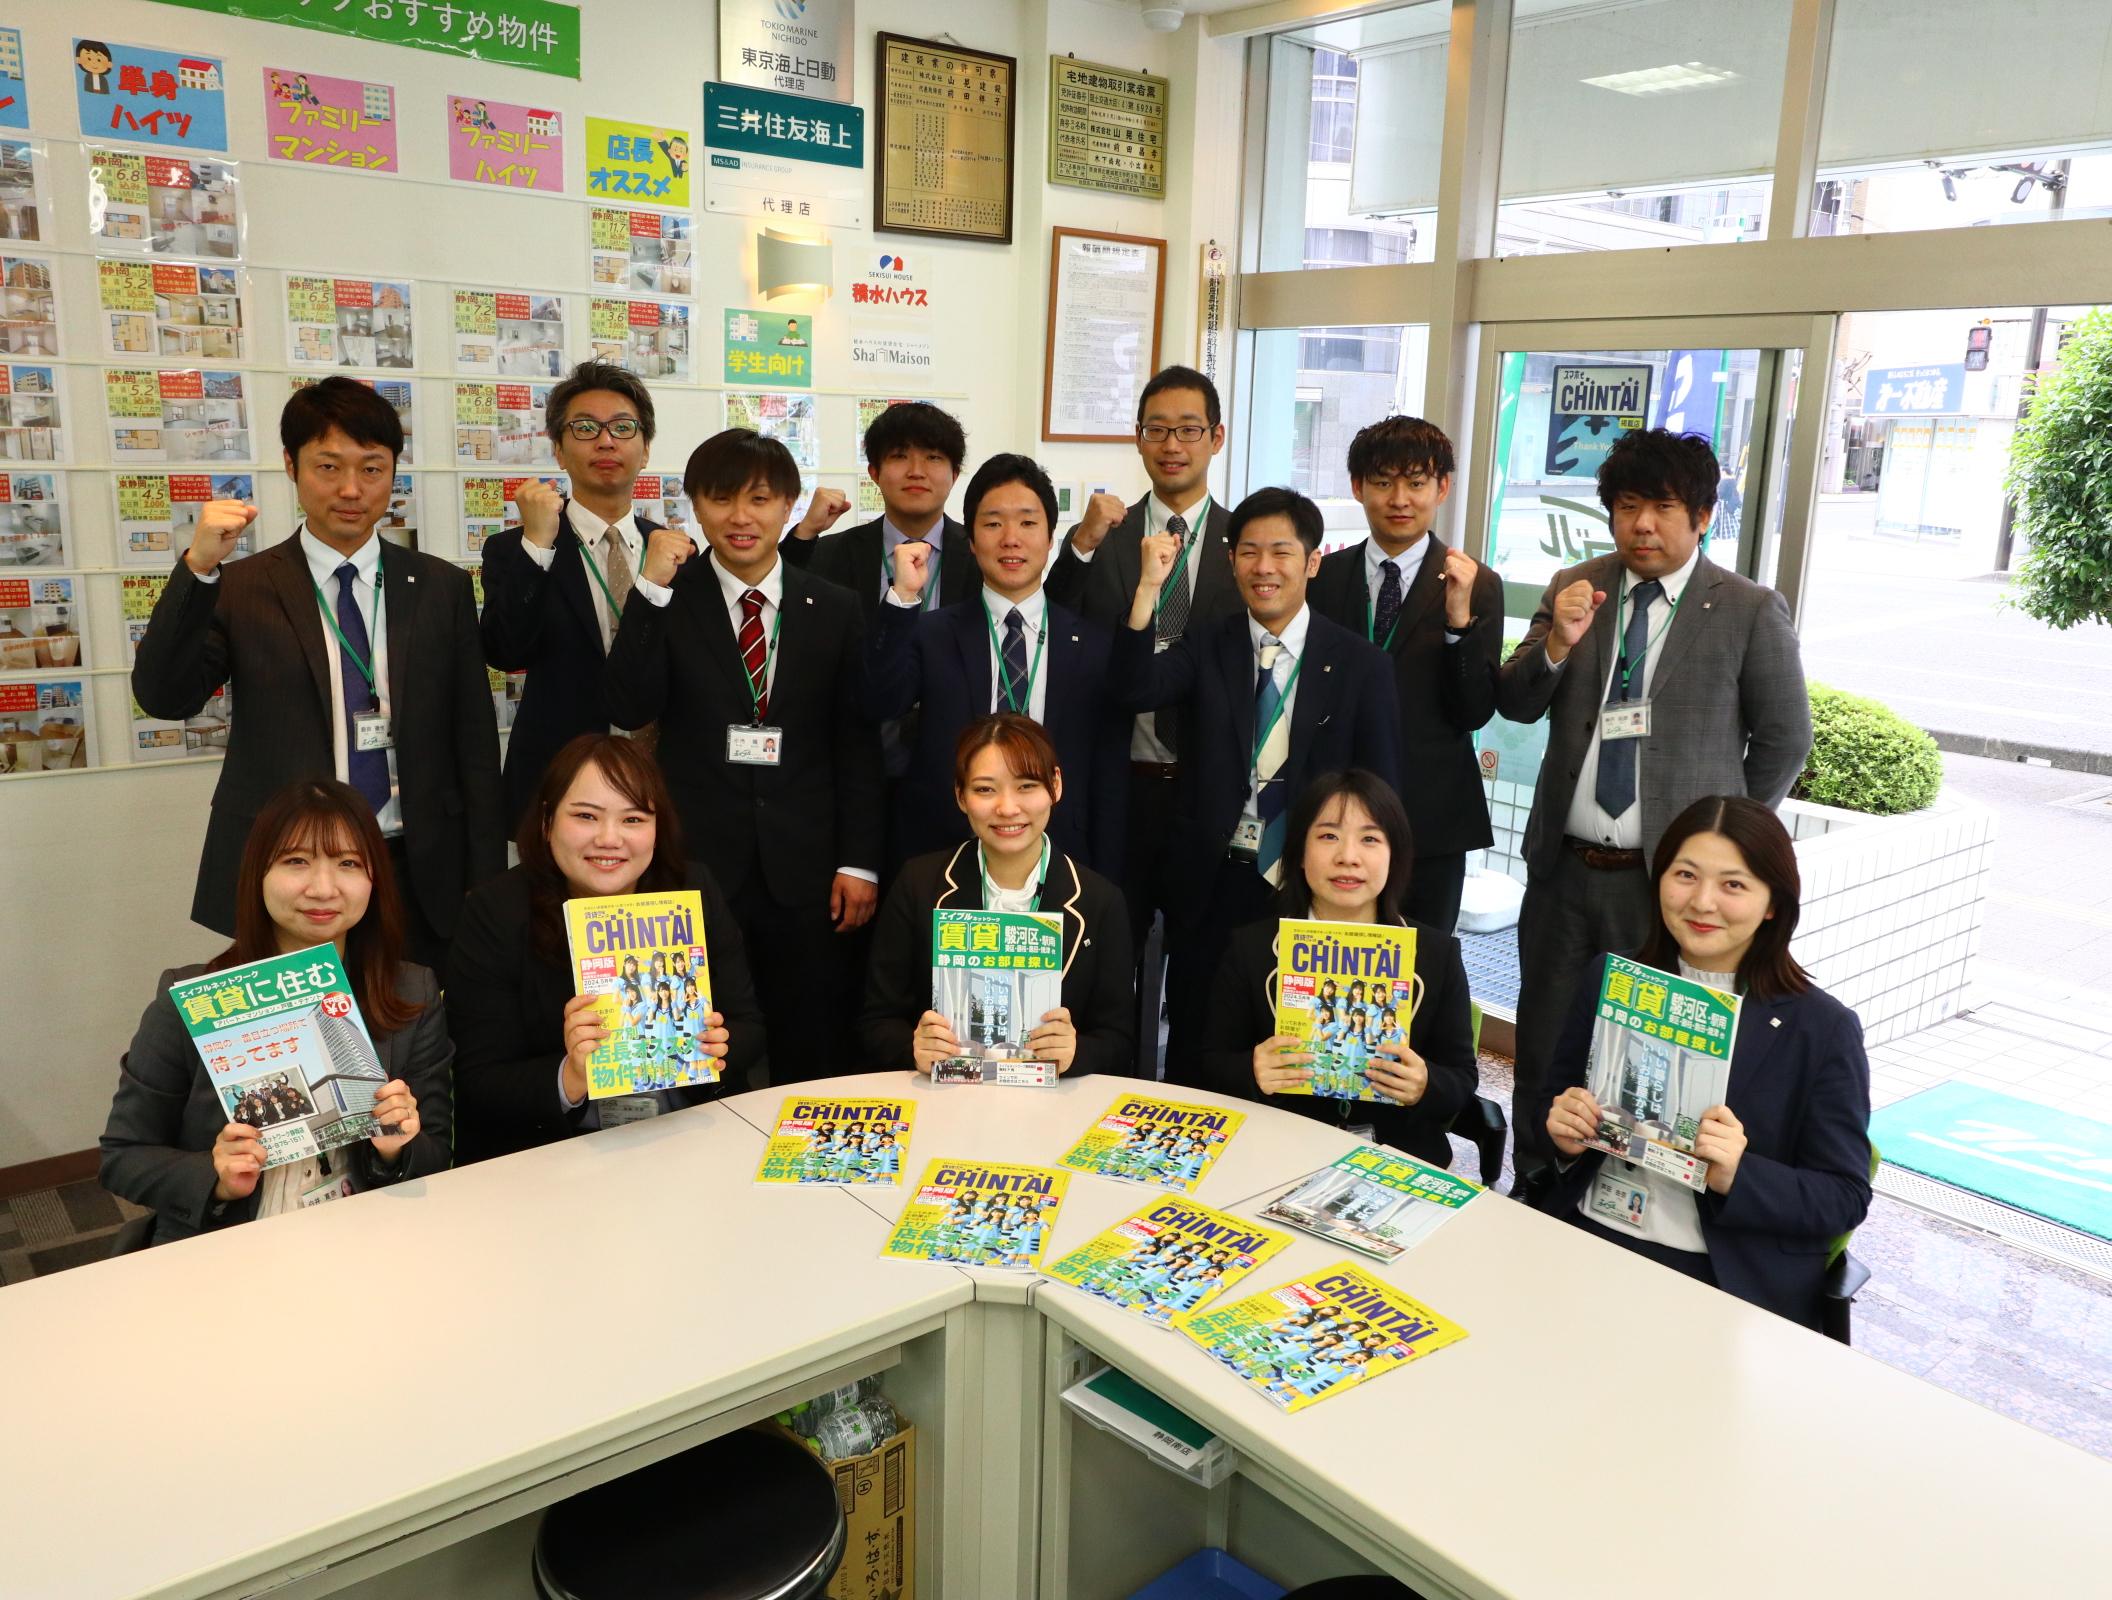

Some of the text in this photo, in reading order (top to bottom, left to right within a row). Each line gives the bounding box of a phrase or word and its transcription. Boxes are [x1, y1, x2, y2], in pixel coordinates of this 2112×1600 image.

[760, 20, 819, 39] TOKIO MARINE
[771, 32, 808, 46] NICHIDO
[742, 47, 836, 82] 東京海上日動
[901, 52, 997, 80] 建設業の許可票
[118, 65, 179, 101] 単身
[774, 75, 806, 91] 代理店
[1066, 70, 1156, 98] 宅地建物取引業者票
[110, 103, 192, 138] ハイツ
[279, 101, 383, 132] ファミリー
[717, 105, 852, 149] 三井住友海上
[273, 135, 390, 170] マンション
[460, 127, 550, 155] ファミリー
[608, 134, 654, 164] 店長
[116, 169, 141, 182] 6.8
[474, 159, 540, 188] ハイツ
[713, 157, 740, 168] MS&AD
[589, 166, 671, 197] オススメ
[763, 197, 811, 216] 代理店
[124, 277, 147, 289] 5.2
[869, 271, 892, 280] SEKISUI
[309, 292, 330, 303] 6.5
[852, 282, 928, 307] 積水ハウス
[474, 305, 492, 316] 7.2
[607, 312, 625, 322] 3.6
[728, 350, 805, 376] 学生向け
[889, 348, 930, 366] Maison
[130, 385, 154, 396] 5.2
[474, 396, 493, 407] 6.8
[1561, 379, 1640, 412] CHINTAI
[141, 489, 164, 500] 4.5
[481, 490, 499, 500] 6.5
[586, 905, 694, 953] CHINTAI
[939, 923, 999, 950] 賃貸
[581, 957, 615, 971] 静岡版
[938, 953, 1056, 968] 静岡のお部屋探し
[1292, 937, 1401, 978] CHINTAI
[179, 970, 259, 999] エイブルネットワーク
[182, 961, 337, 1025] 賃貸に住む
[1283, 975, 1315, 987] 静岡版
[1605, 971, 1666, 1019] 賃貸
[1601, 1003, 1723, 1055] 静岡のお部屋探し
[210, 1036, 301, 1074] 待ってます
[793, 1103, 902, 1120] CHINTAI
[1120, 1103, 1228, 1130] CHINTAI
[1347, 1152, 1418, 1181] 賃貸
[935, 1168, 1053, 1194] CHINTAI
[1149, 1206, 1271, 1254] CHINTAI
[1315, 1275, 1439, 1344] CHINTAI
[1152, 1431, 1193, 1456] 静岡南店
